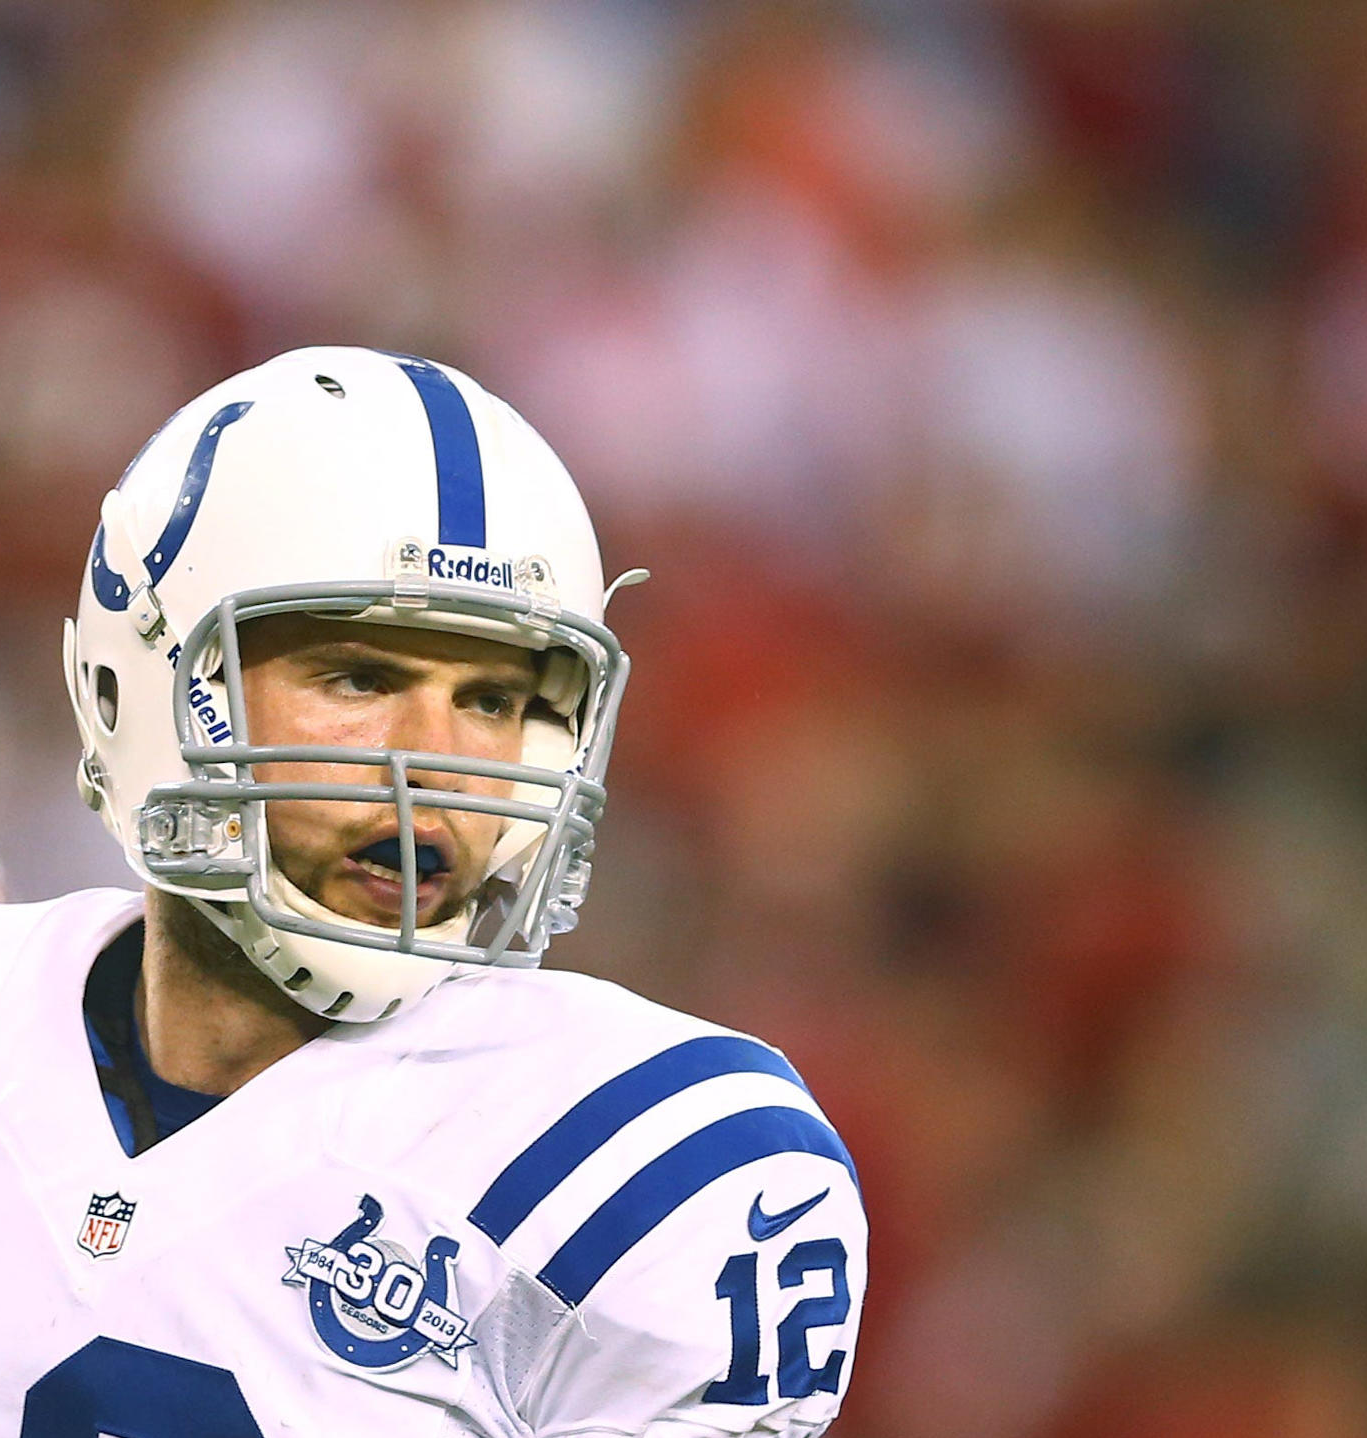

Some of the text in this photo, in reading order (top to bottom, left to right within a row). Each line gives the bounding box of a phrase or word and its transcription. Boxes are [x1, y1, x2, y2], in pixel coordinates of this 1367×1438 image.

[428, 548, 513, 589] Riddell
[82, 1218, 120, 1250] NFL
[334, 1240, 425, 1325] 30
[340, 1303, 389, 1334] SEASONS
[422, 1311, 456, 1336] 2013
[702, 1238, 851, 1405] 12
